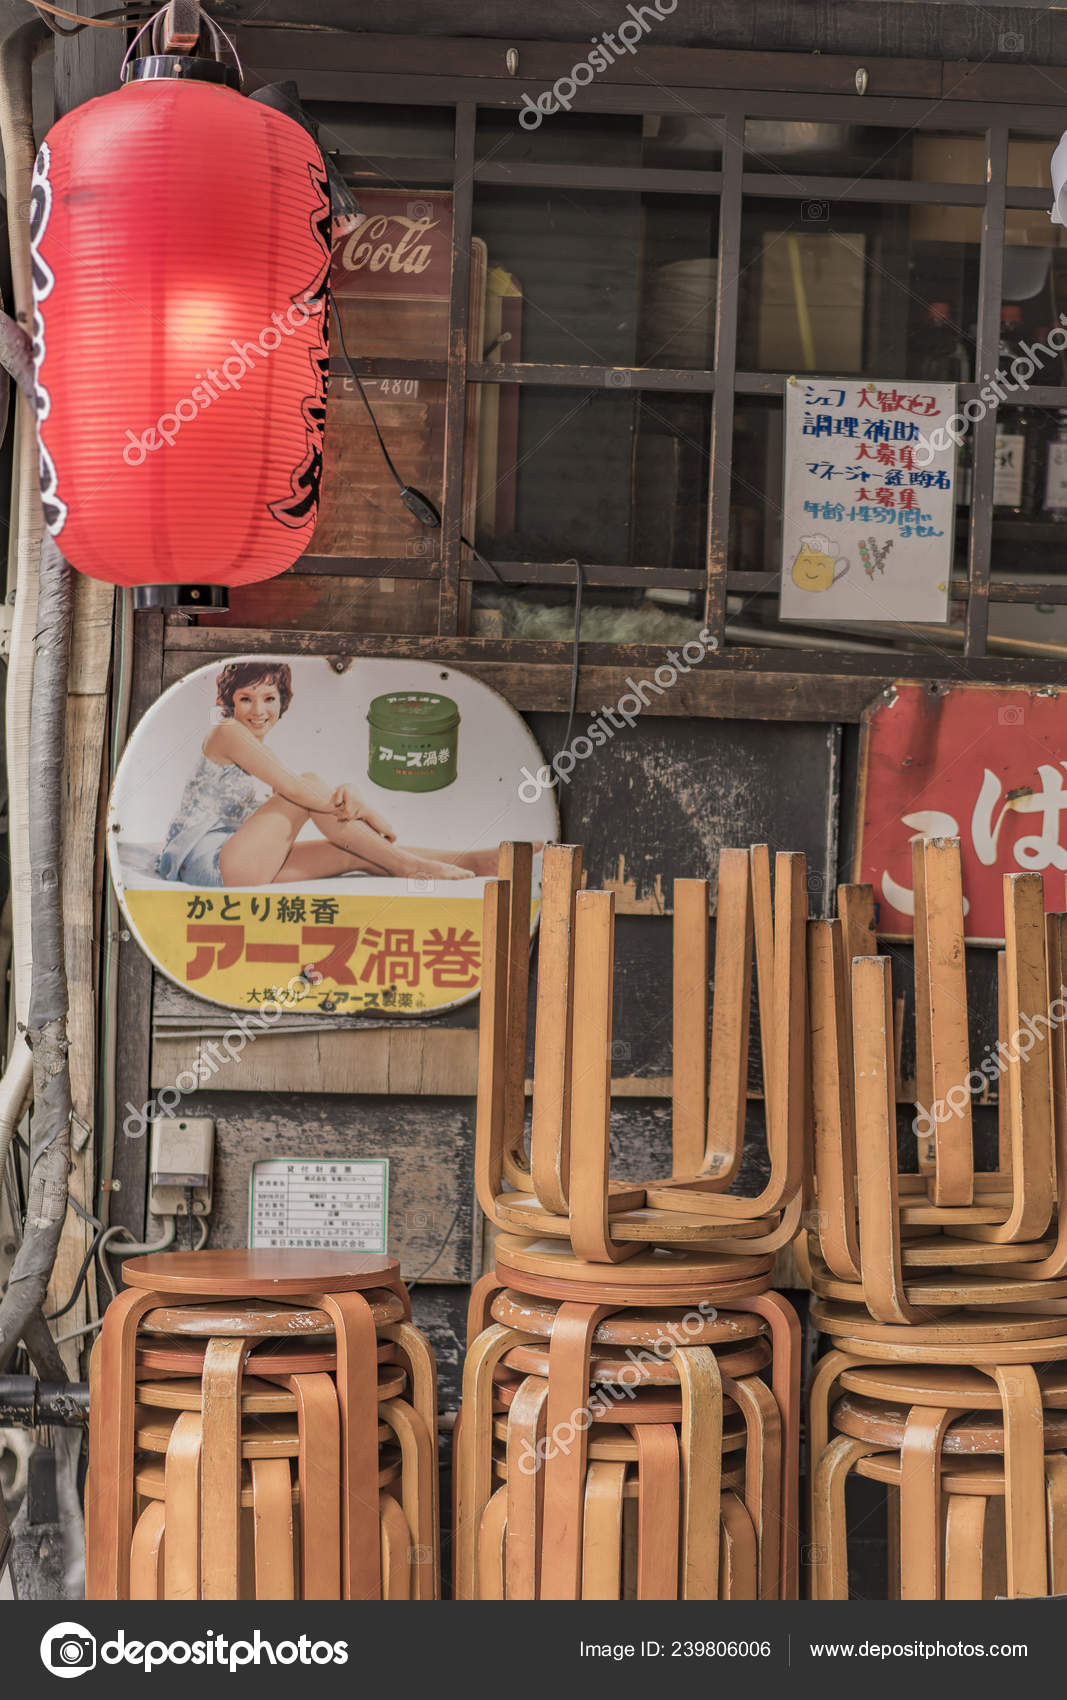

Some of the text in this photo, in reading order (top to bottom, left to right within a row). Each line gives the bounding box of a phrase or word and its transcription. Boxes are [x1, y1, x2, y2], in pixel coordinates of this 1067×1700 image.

[331, 215, 440, 274] Cola
[803, 386, 847, 408] シェフ
[803, 411, 920, 443] 調理補助
[855, 443, 922, 471] 大募集
[855, 487, 922, 510] 大募集
[899, 525, 945, 538] ません
[379, 745, 450, 767] アース渦巻
[186, 895, 340, 924] かとり線香
[186, 923, 482, 989] アース渦巻
